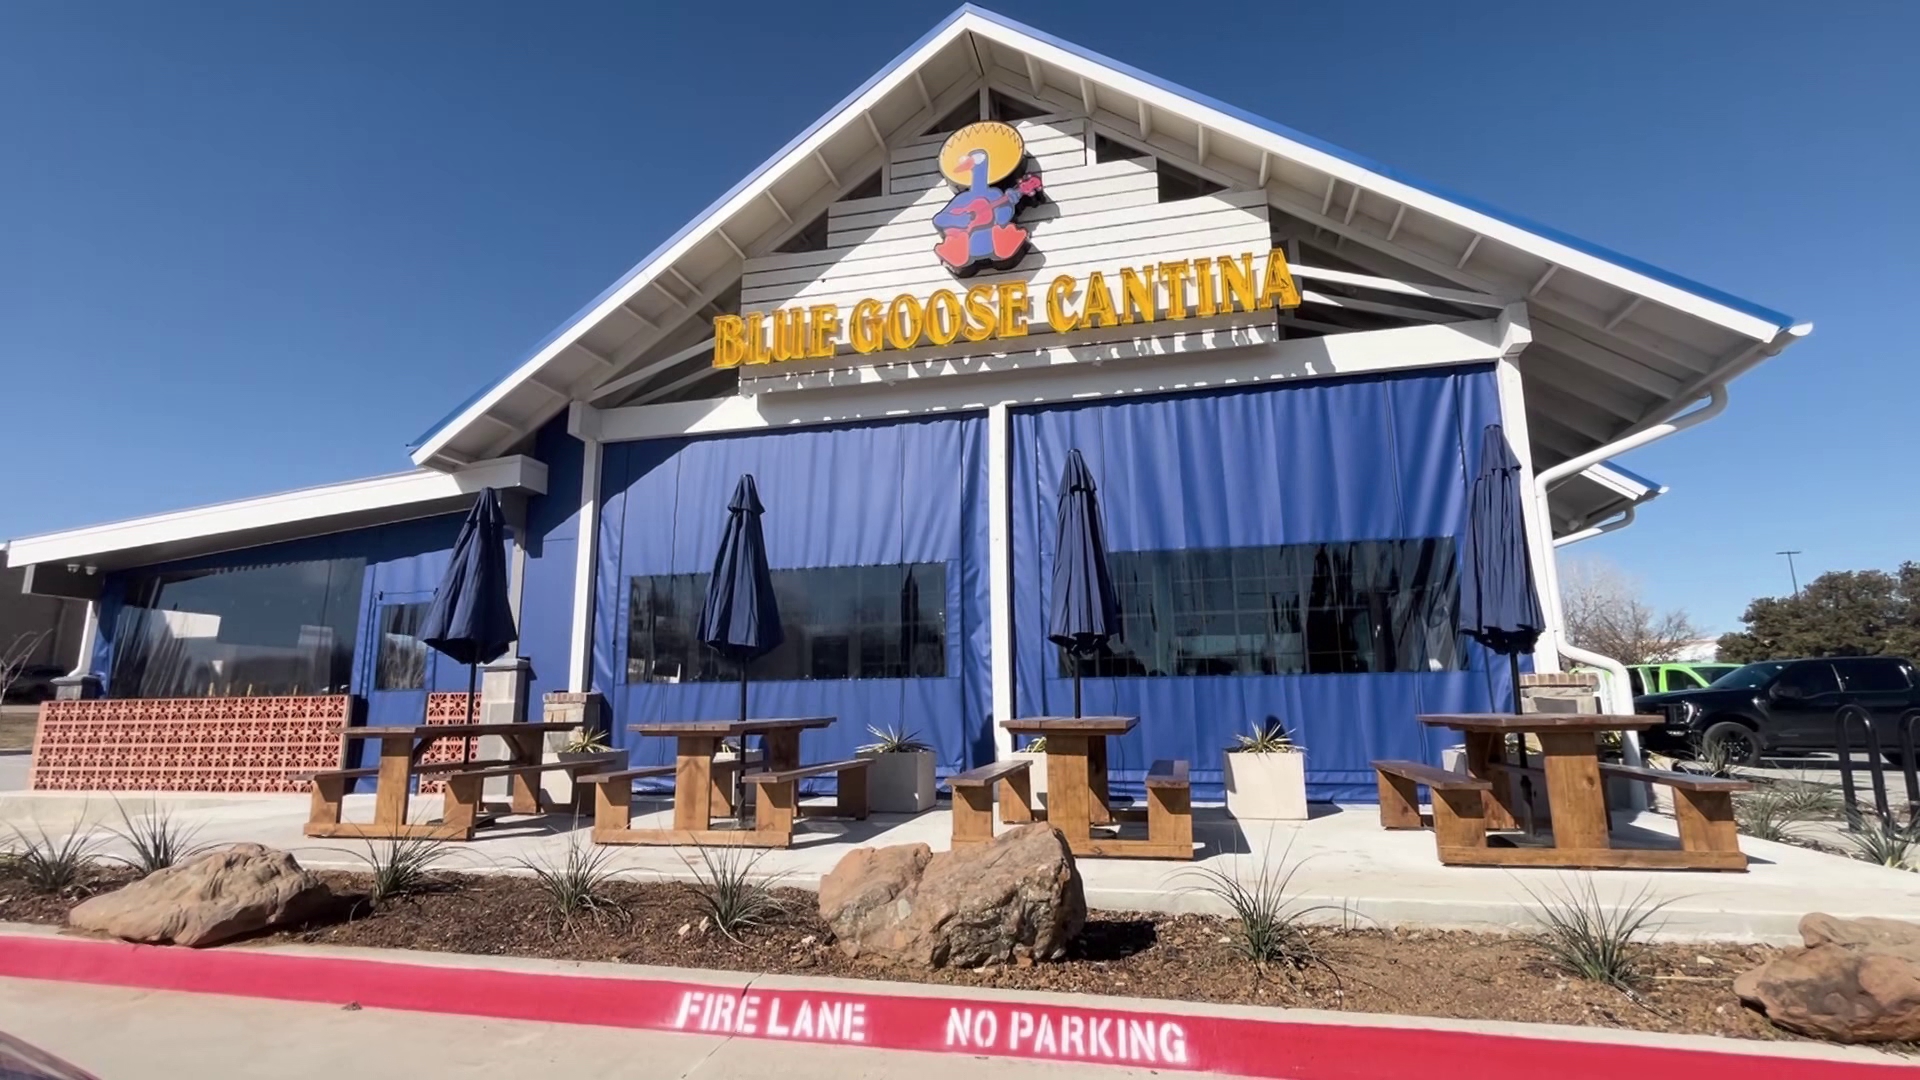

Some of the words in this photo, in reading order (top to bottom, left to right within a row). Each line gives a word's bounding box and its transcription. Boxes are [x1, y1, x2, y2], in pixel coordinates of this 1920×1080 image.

[711, 304, 838, 369] BLUE
[848, 280, 1028, 355] GOOSE
[1046, 247, 1301, 334] CANTINA
[675, 991, 761, 1034] FIRE
[766, 997, 866, 1042] LANE
[945, 1007, 998, 1047] NO
[1009, 1011, 1189, 1063] PARKING
